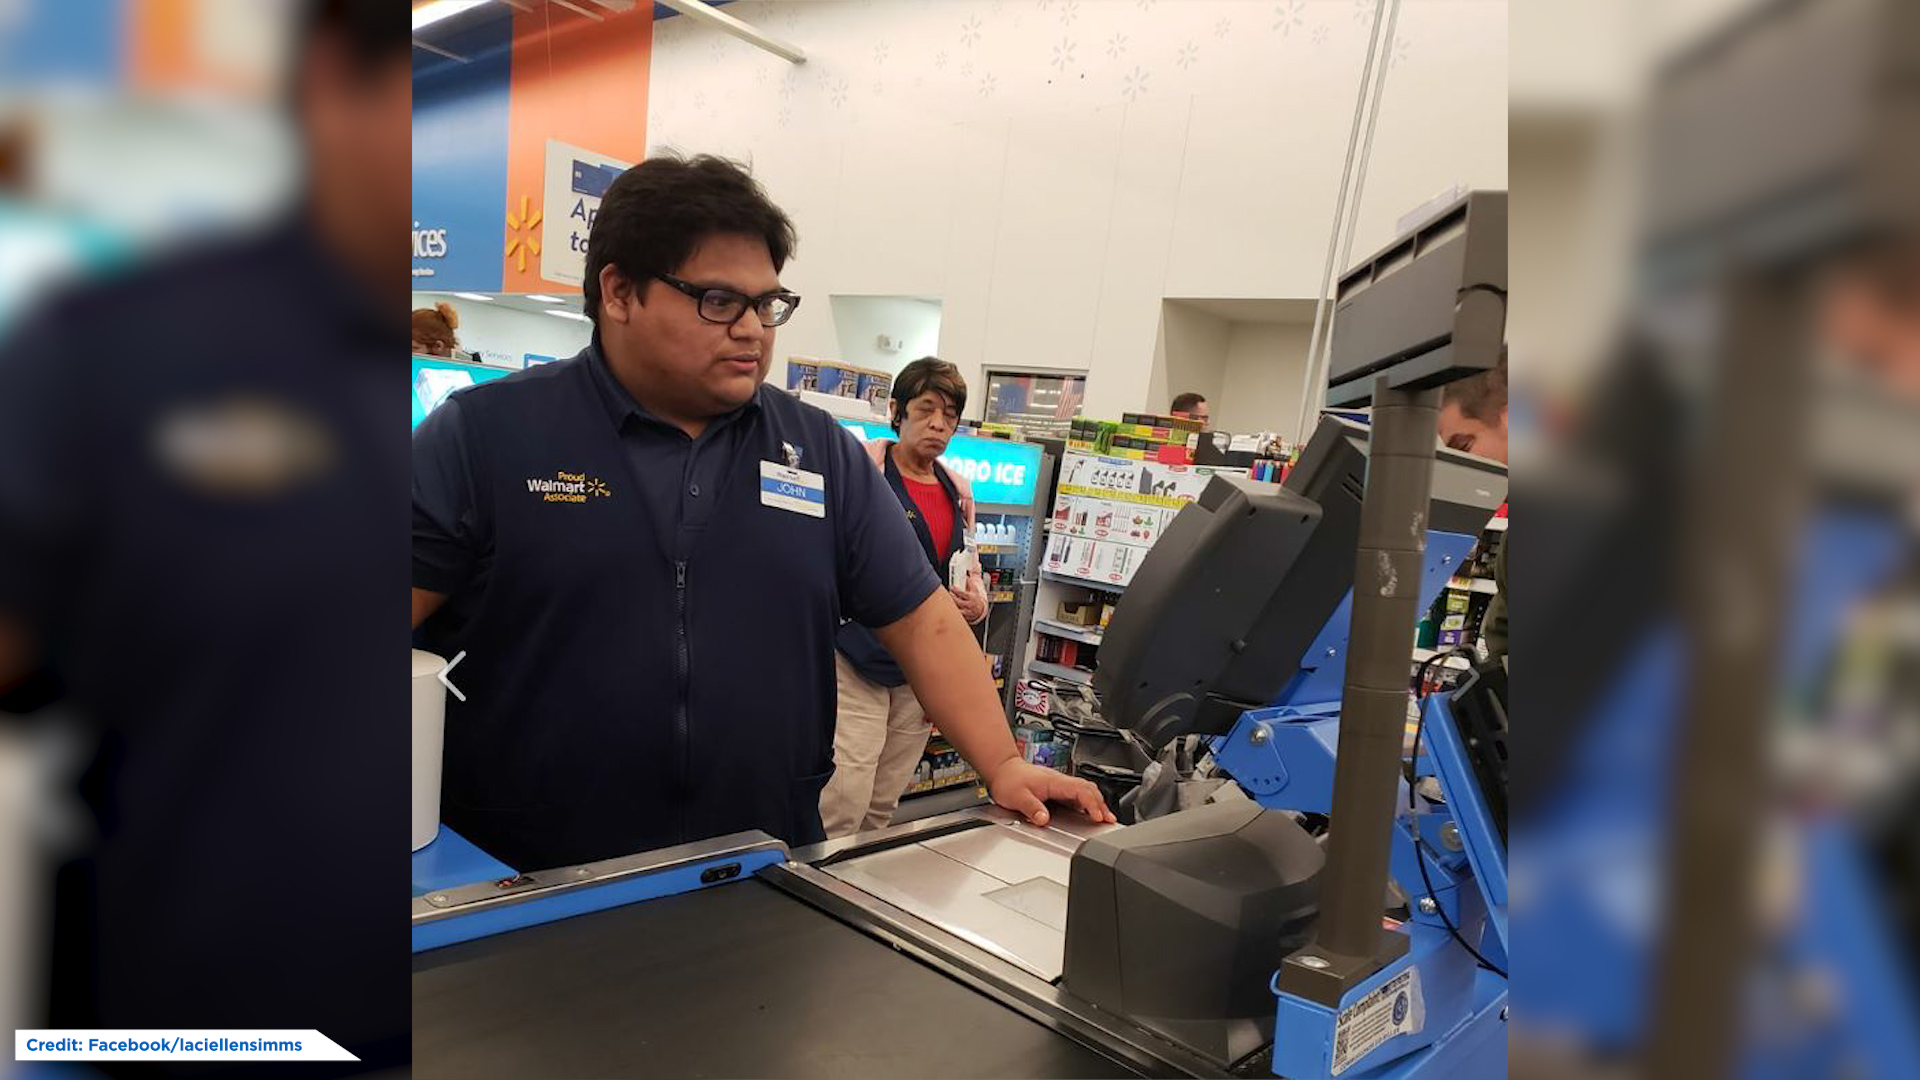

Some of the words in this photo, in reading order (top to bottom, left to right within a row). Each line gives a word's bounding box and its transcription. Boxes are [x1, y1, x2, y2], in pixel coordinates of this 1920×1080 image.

[557, 471, 586, 482] Proud
[994, 461, 1026, 486] ICE
[526, 479, 586, 494] Walmart
[776, 482, 807, 499] JOHN
[543, 491, 588, 503] Associate
